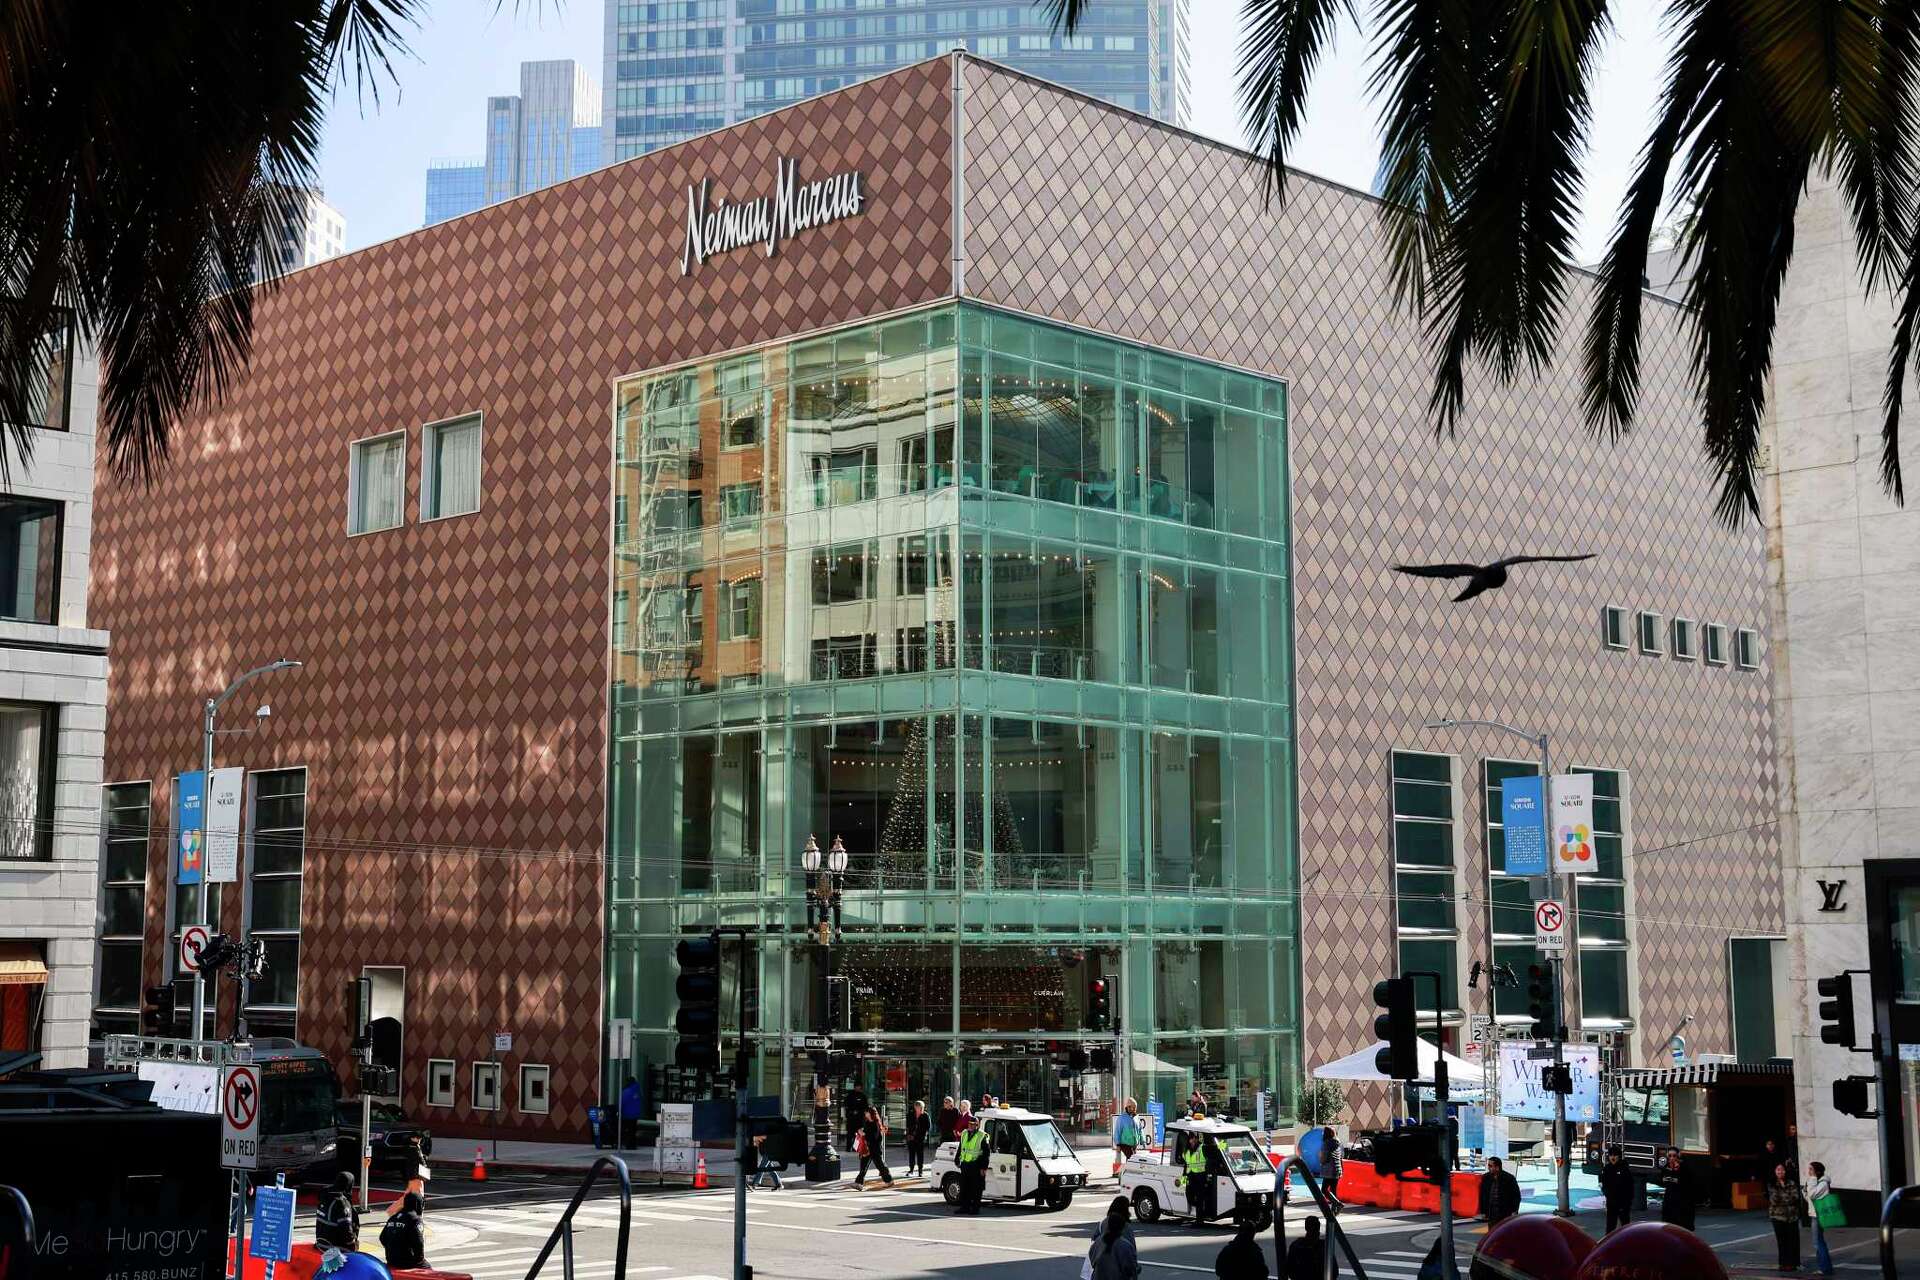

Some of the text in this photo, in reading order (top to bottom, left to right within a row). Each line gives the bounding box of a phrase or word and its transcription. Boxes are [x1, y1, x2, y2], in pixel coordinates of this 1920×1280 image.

[680, 156, 865, 276] Neiman Marcus
[1510, 802, 1536, 810] SQUARE
[1538, 936, 1562, 944] ON RED
[224, 1138, 256, 1157] ON RED
[107, 1226, 201, 1257] Hungry
